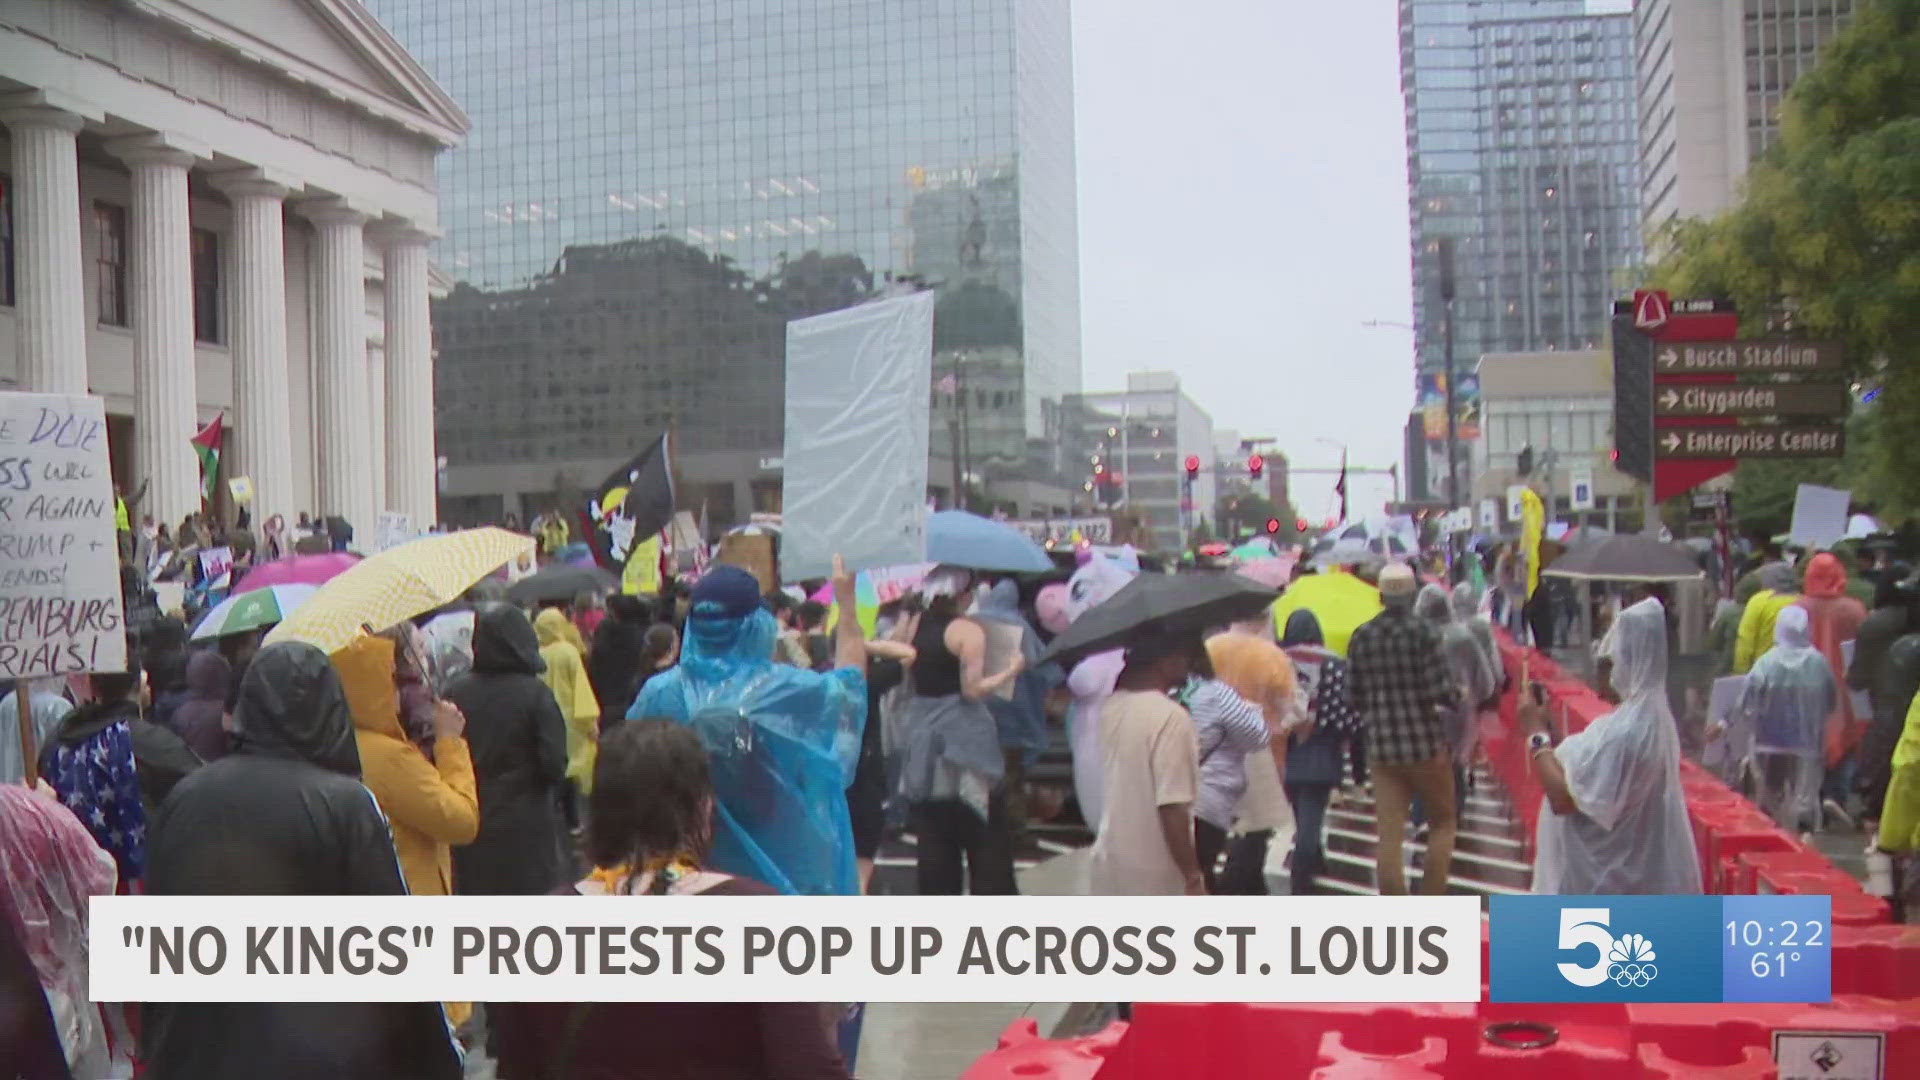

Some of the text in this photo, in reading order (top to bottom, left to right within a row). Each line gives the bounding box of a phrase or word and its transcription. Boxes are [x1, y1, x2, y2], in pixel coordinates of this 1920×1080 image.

[1684, 346, 1818, 366] Busch Stadium
[1683, 388, 1775, 415] Citygarden
[1686, 431, 1838, 456] Enterprise Center
[25, 494, 105, 521] AGAIN
